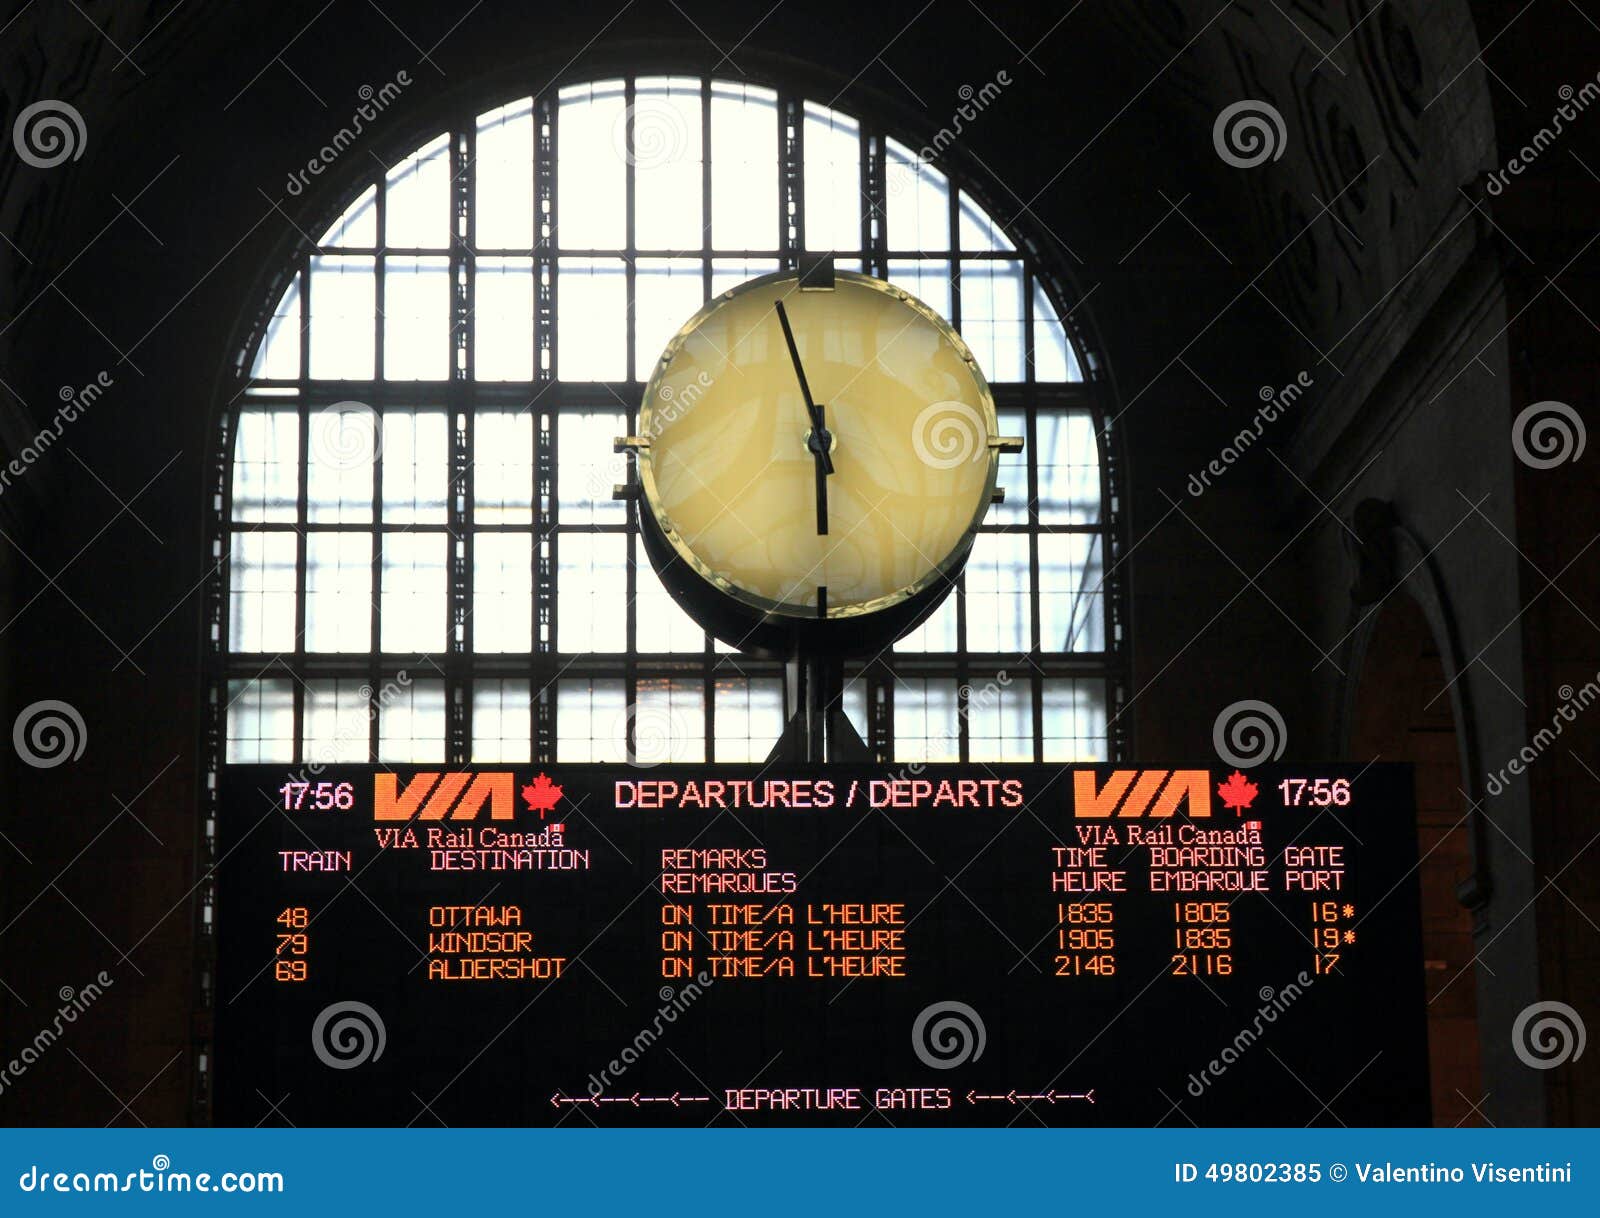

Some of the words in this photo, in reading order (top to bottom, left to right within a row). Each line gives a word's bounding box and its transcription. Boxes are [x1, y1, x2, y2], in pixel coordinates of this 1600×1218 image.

[280, 782, 353, 809] 17:56
[375, 772, 514, 820] VIA
[616, 781, 834, 808] DEPARTURES
[870, 780, 1022, 807] DEPARTS
[1074, 770, 1211, 817] VIA
[1279, 779, 1350, 805] 17:56
[375, 829, 419, 848] VIA
[427, 828, 474, 848] Rail
[480, 826, 564, 847] Canada
[1076, 826, 1119, 845] VIA
[1127, 825, 1173, 844] Rail
[1179, 823, 1261, 844] Canada
[279, 851, 350, 871] TRAIN
[431, 850, 588, 870] DESTINATION
[662, 849, 766, 869] REMARKS
[1052, 848, 1107, 867] TIME
[1150, 847, 1264, 866] BOARDING
[1285, 847, 1344, 866] GATE
[662, 873, 796, 893] REMARQUES
[1053, 872, 1126, 891] HEURE
[1151, 871, 1269, 891] EMBARQUE
[1286, 871, 1344, 890] PORT
[277, 908, 307, 927] 48
[430, 906, 520, 926] OTTAWA
[662, 905, 692, 924] ON
[707, 905, 793, 924] TIME/A
[808, 904, 904, 924] L'HEURE
[1059, 904, 1112, 923] 1835
[1176, 903, 1229, 922] 1805
[277, 934, 307, 954] 79
[430, 932, 532, 952] WINDSOR
[662, 931, 692, 951] ON
[708, 931, 793, 950] TIME/A
[809, 930, 904, 950] L'HEURE
[1060, 930, 1114, 949] 1905
[1177, 929, 1230, 948] 1835
[276, 961, 306, 981] 69
[430, 958, 565, 979] ALDERSHOT
[662, 958, 692, 977] ON
[708, 957, 794, 977] TIME/A
[809, 956, 905, 976] L'HEURE
[1055, 956, 1114, 975] 2146
[1172, 955, 1231, 974] 2116
[1316, 954, 1339, 974] 17
[725, 1089, 860, 1109] DEPARTURE
[876, 1089, 950, 1108] GATES
